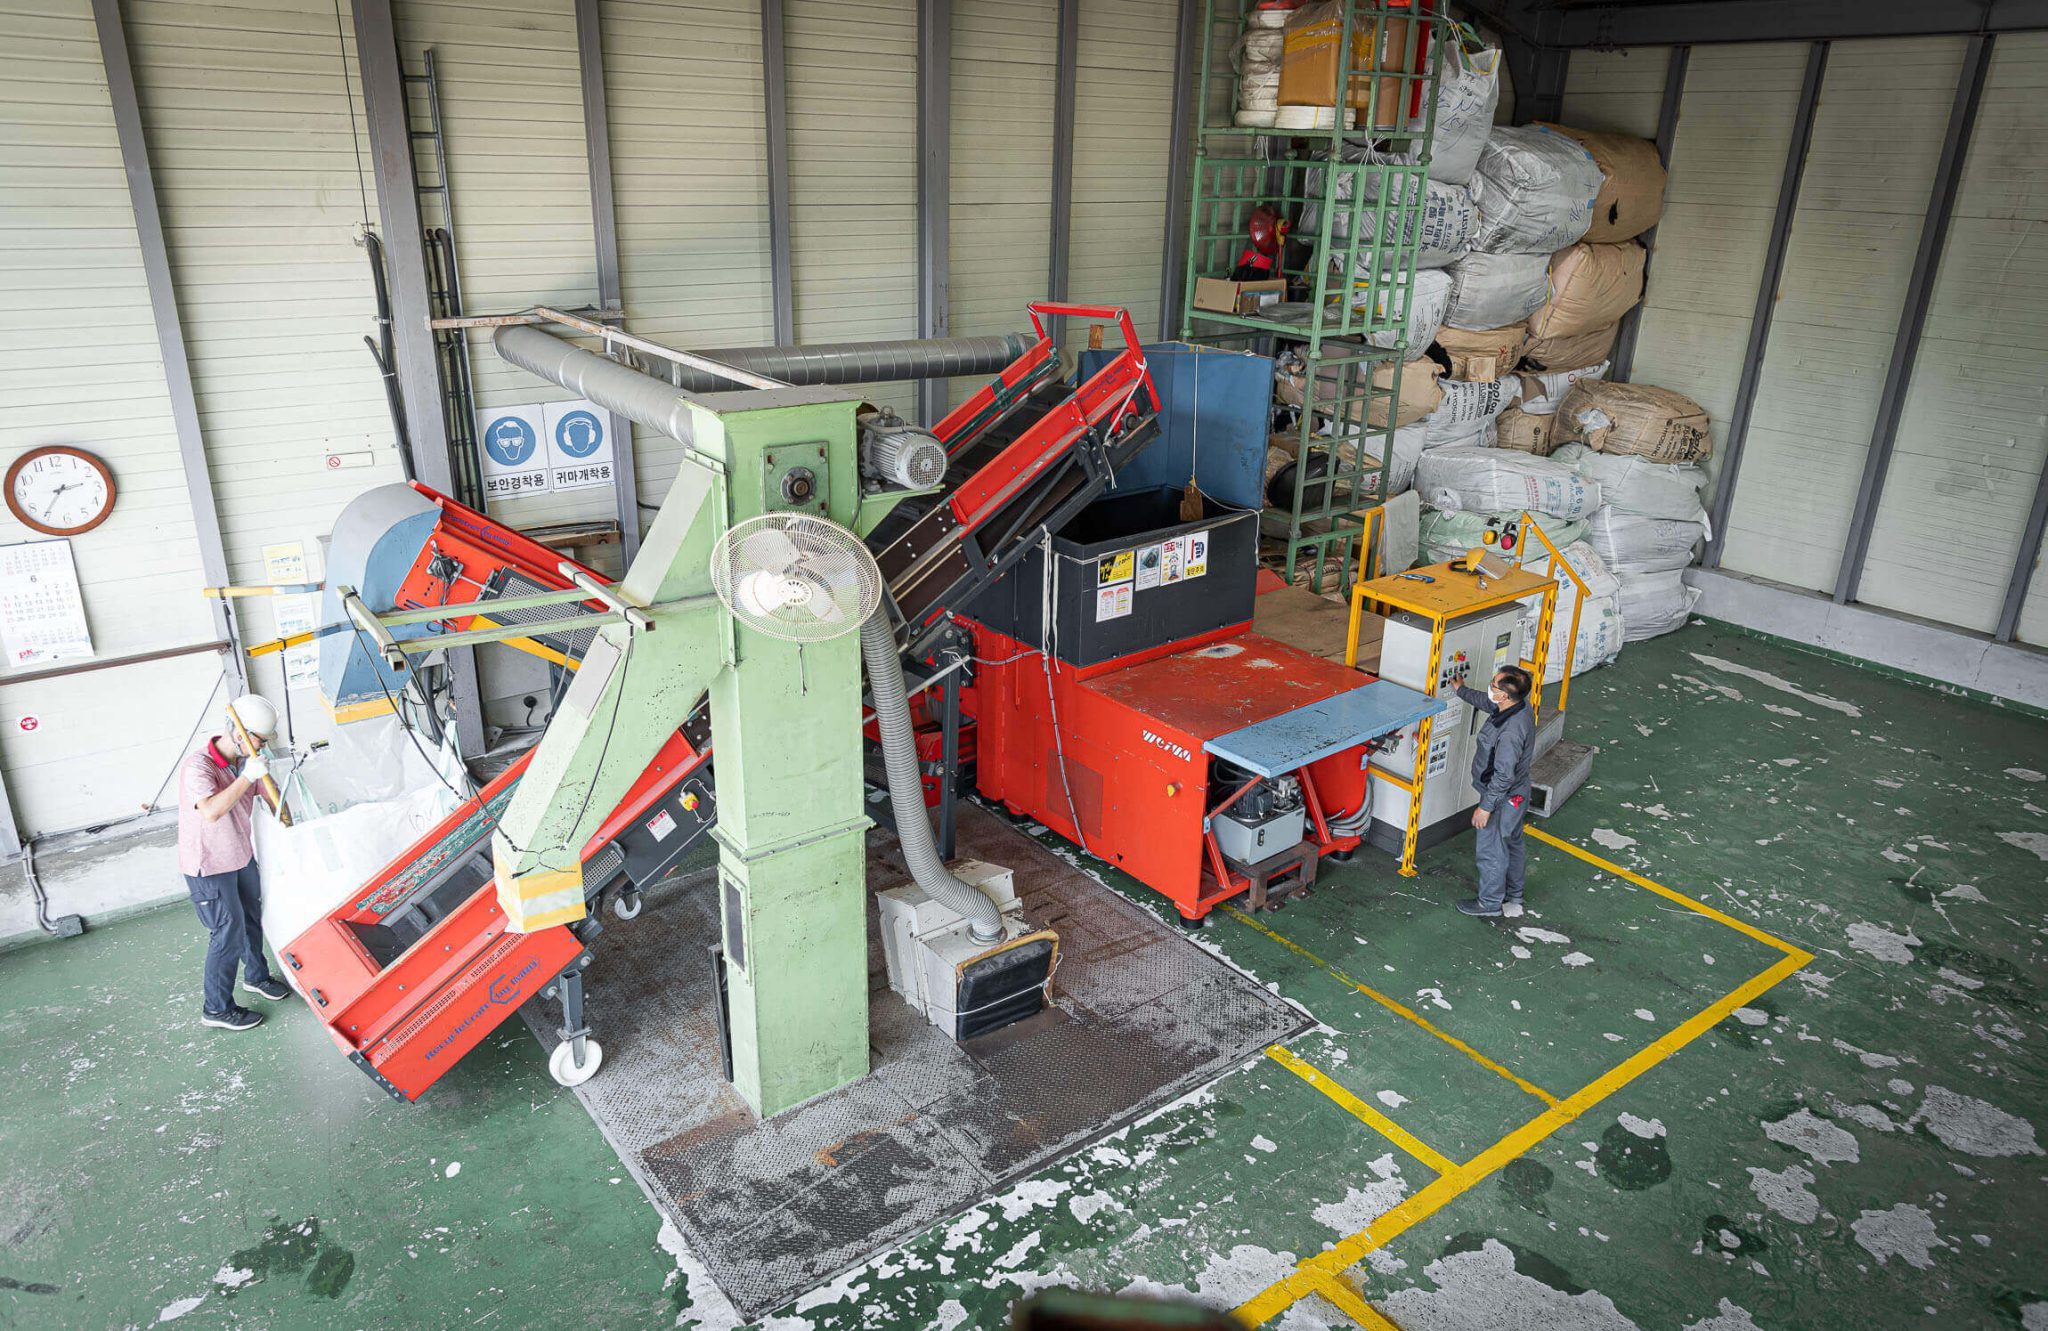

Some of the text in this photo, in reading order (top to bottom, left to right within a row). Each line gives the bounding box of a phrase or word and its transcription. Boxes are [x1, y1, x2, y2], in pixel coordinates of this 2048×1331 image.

[33, 461, 43, 472] 11
[48, 455, 62, 468] 12
[84, 466, 92, 478] 2
[556, 466, 611, 485] 귀마개착용
[21, 474, 33, 486] 10
[487, 473, 545, 492] 보안경착용
[94, 481, 102, 492] 3
[18, 488, 26, 500] 9
[28, 502, 37, 513] 8
[92, 496, 99, 507] 4
[63, 512, 72, 524] 6
[80, 507, 89, 518] 5
[30, 575, 37, 583] 6
